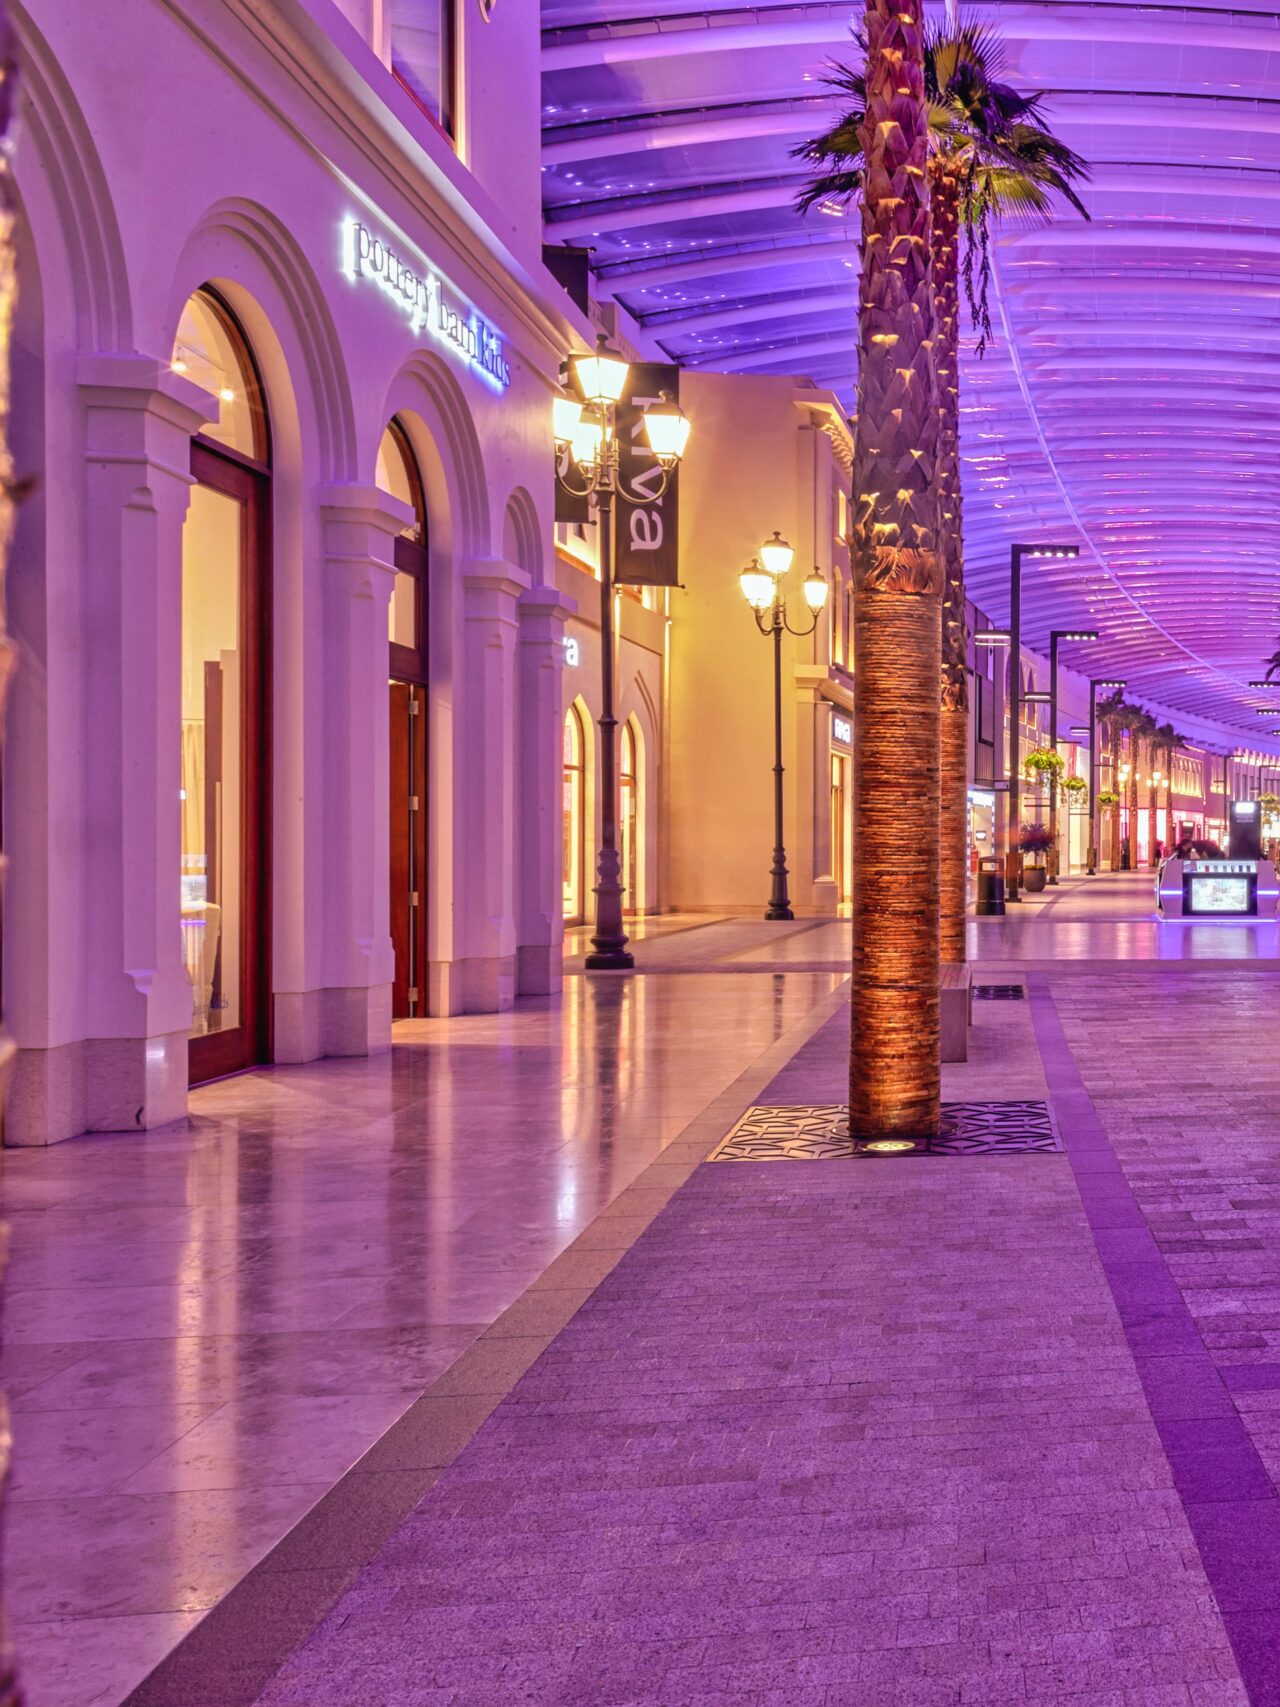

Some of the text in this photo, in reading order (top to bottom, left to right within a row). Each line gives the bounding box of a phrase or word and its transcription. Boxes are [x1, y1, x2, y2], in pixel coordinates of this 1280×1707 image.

[347, 220, 511, 388] pottery barn kids
